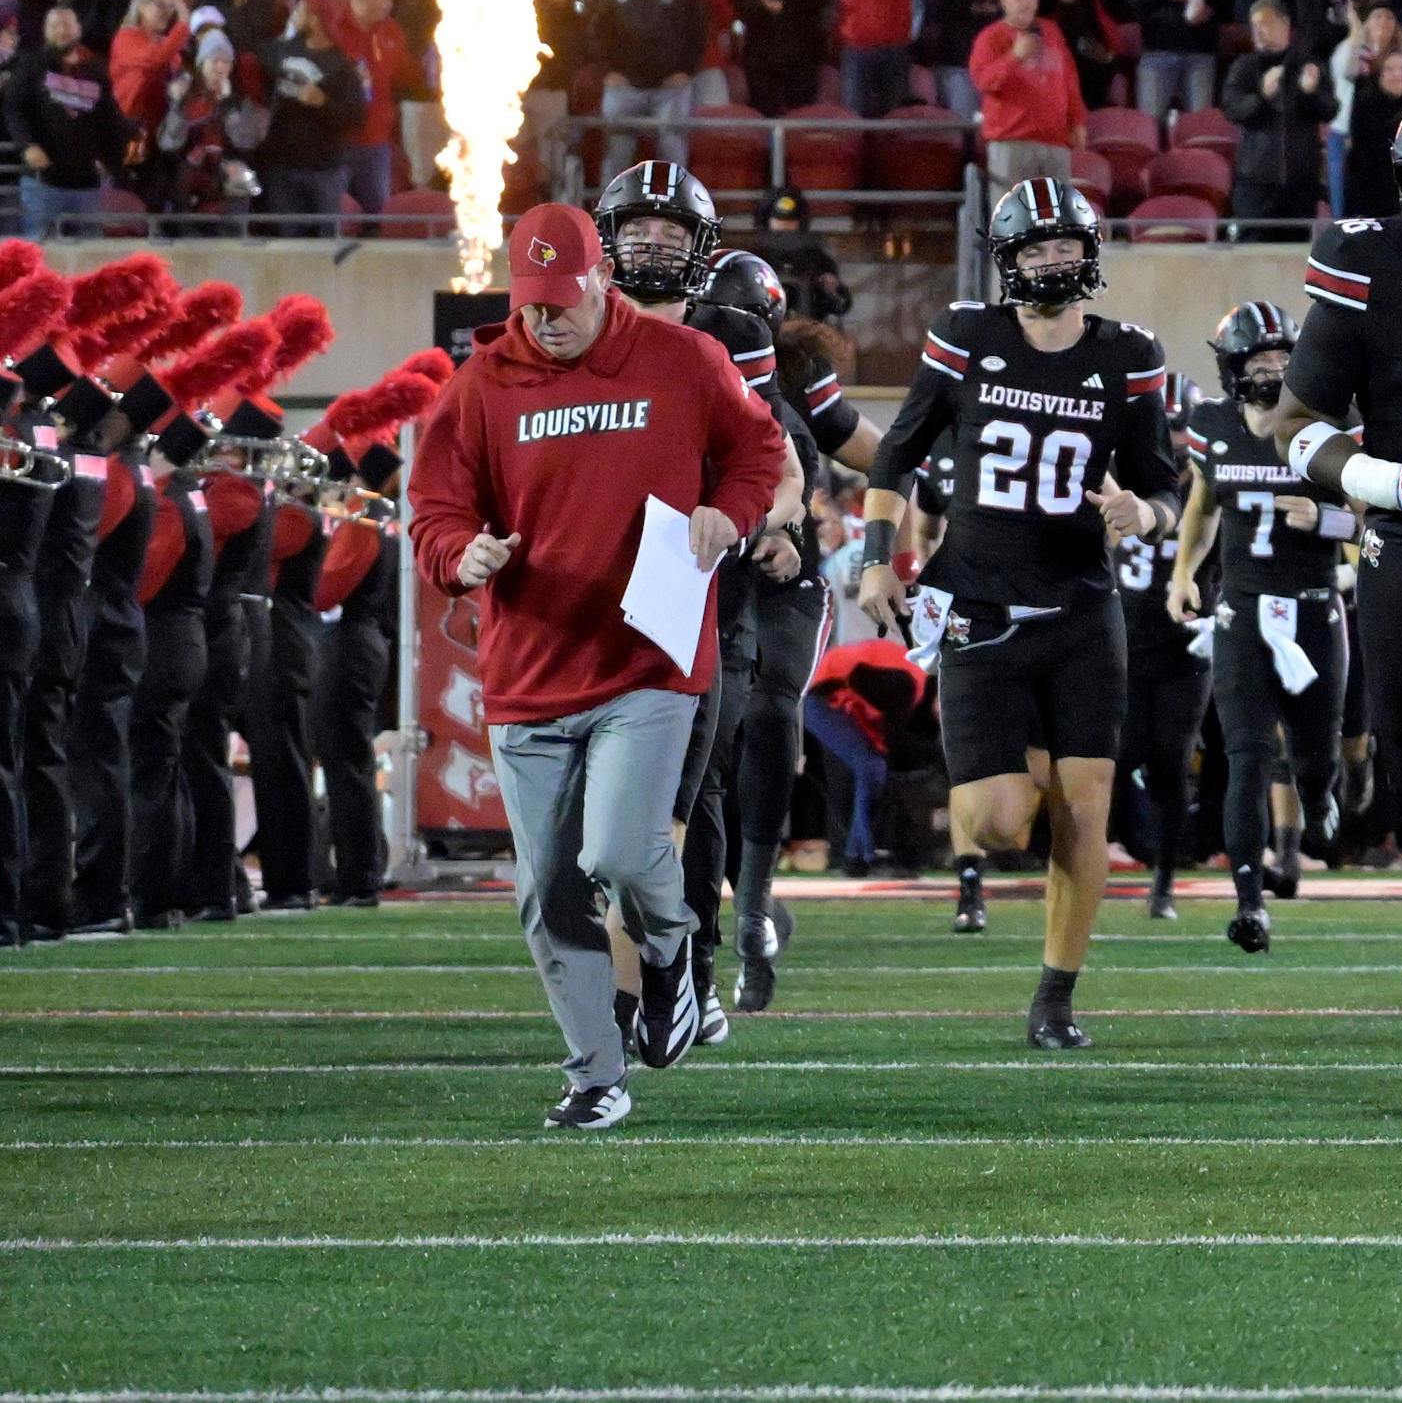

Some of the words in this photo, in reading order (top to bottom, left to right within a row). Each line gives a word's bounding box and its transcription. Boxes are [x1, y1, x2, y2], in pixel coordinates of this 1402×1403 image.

[517, 400, 649, 443] LOUISVILLE
[978, 383, 1105, 420] LOUISVILLE
[978, 419, 1092, 515] 20
[1237, 491, 1275, 557] 7
